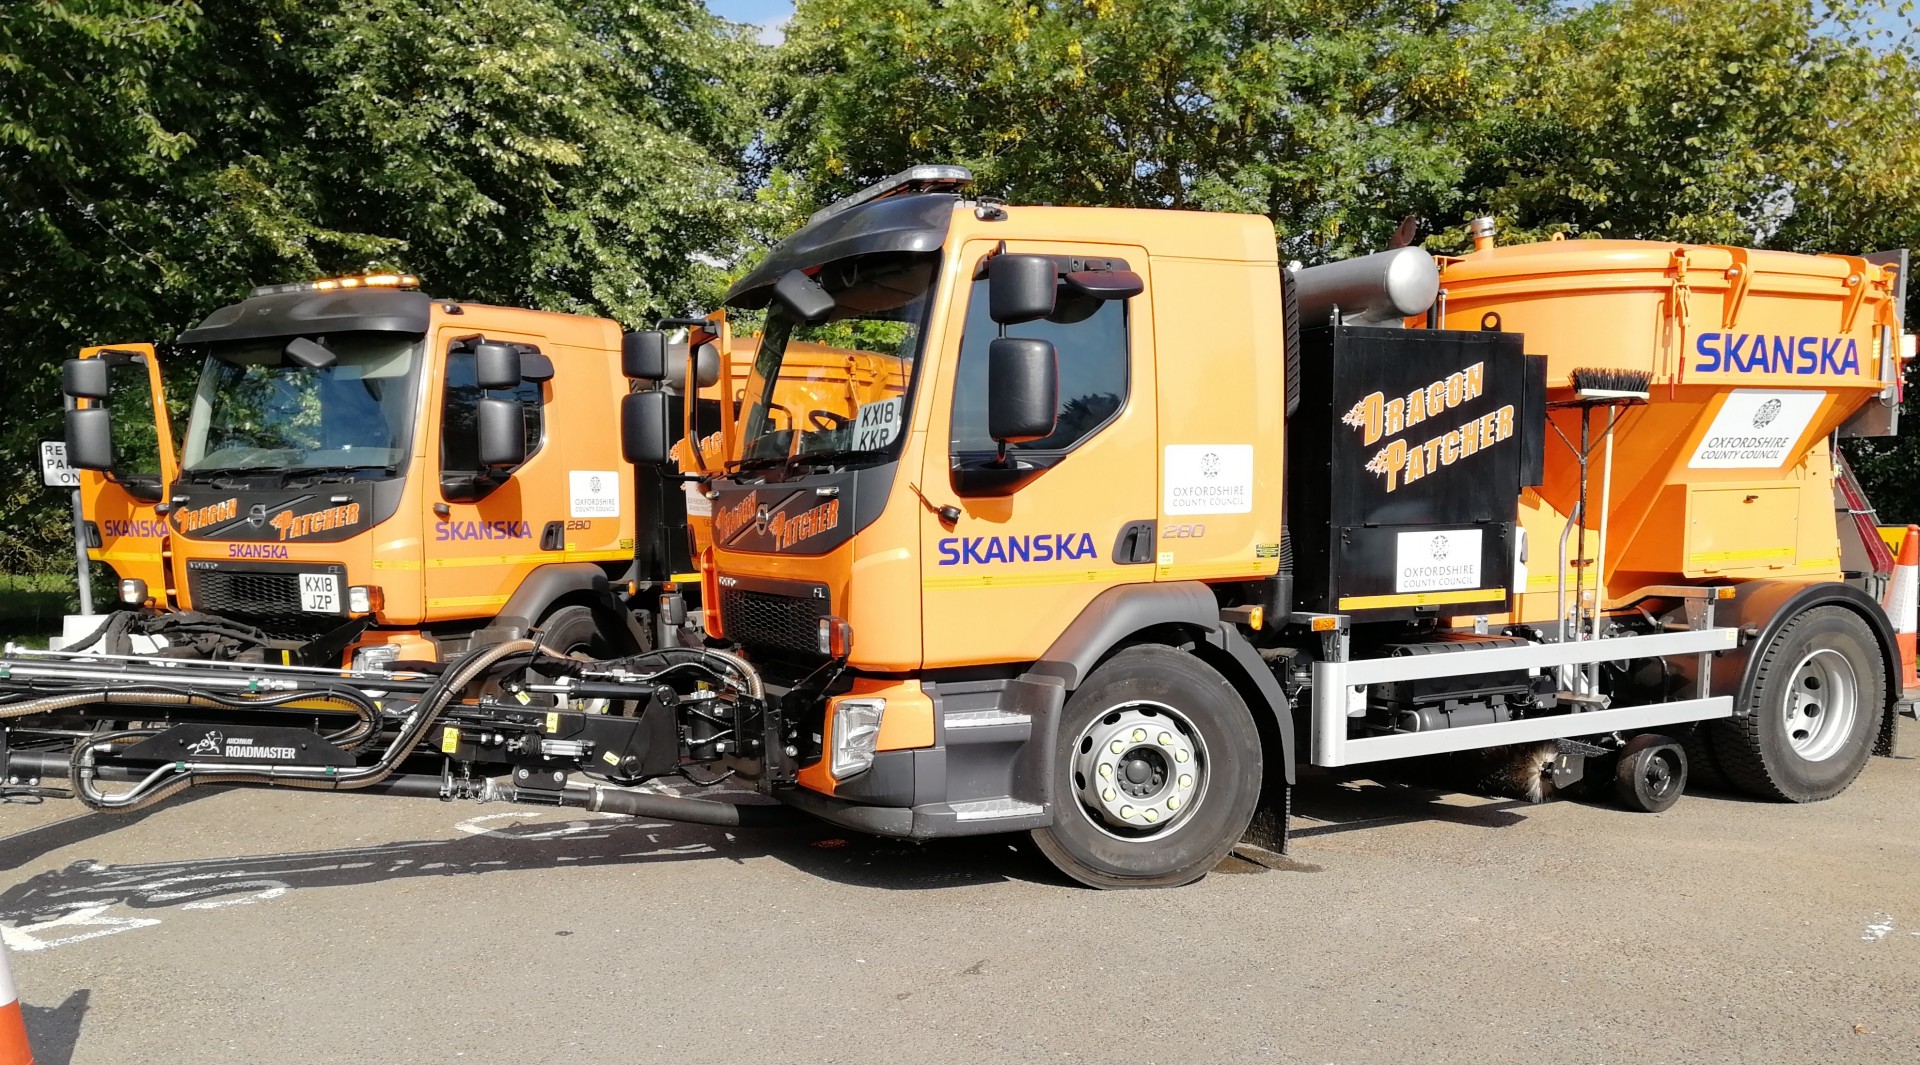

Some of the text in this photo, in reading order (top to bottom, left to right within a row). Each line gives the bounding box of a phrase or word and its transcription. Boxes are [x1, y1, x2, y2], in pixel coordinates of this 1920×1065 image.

[1695, 332, 1860, 376] SKANSKA
[1341, 361, 1484, 447] DRAGON
[861, 401, 894, 428] KX18
[859, 427, 889, 451] KKR
[1708, 437, 1789, 449] OXFORDSHIRE
[45, 445, 66, 456] RE
[1364, 405, 1515, 493] PATCHER
[1701, 450, 1780, 460] COUNTY COUNCIL
[1173, 485, 1244, 497] OXFORDSHIRE
[574, 498, 615, 507] OXFORDSHIRE
[1172, 497, 1244, 508] COUNTY COUNCIL
[104, 519, 169, 538] SKANSKA
[269, 503, 360, 541] PATCHER
[566, 520, 591, 531] 280
[768, 499, 840, 552] PATCHER
[435, 520, 532, 542] SKANSKA
[1162, 524, 1206, 539] 280
[228, 544, 288, 559] SKANSKA
[938, 532, 1098, 566] SKANSKA
[1404, 565, 1474, 578] OXFORDSHIRE
[305, 577, 332, 592] KX18
[1404, 576, 1473, 588] COUNTY COUNCIL
[309, 595, 332, 610] JZP
[225, 745, 296, 760] ROADMASTER
